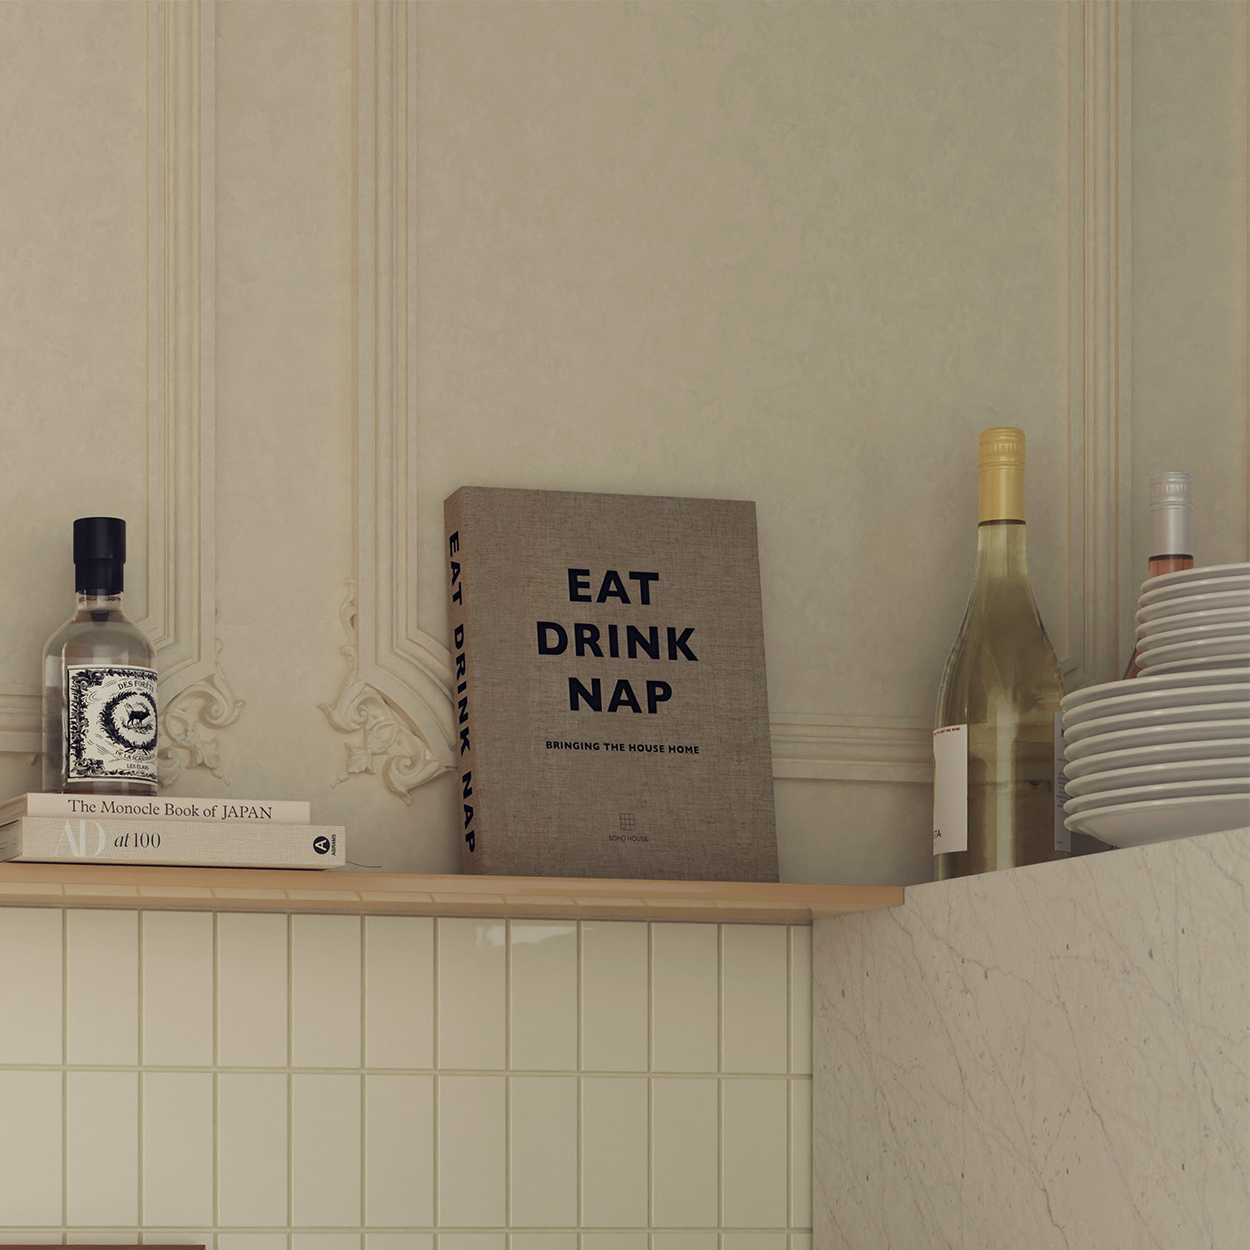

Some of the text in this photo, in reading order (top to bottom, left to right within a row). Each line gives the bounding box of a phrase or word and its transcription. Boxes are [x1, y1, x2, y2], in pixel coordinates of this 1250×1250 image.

[567, 567, 660, 605] EAT
[536, 620, 699, 661] DRINK
[118, 680, 133, 690] DES
[449, 531, 476, 854] EAT DRINK NAP
[568, 677, 673, 714] NAP
[546, 740, 700, 754] BRINGING THE HOUSE HOME
[68, 799, 273, 820] The Monocle Book of JAPAN
[55, 817, 161, 858] AD at 100
